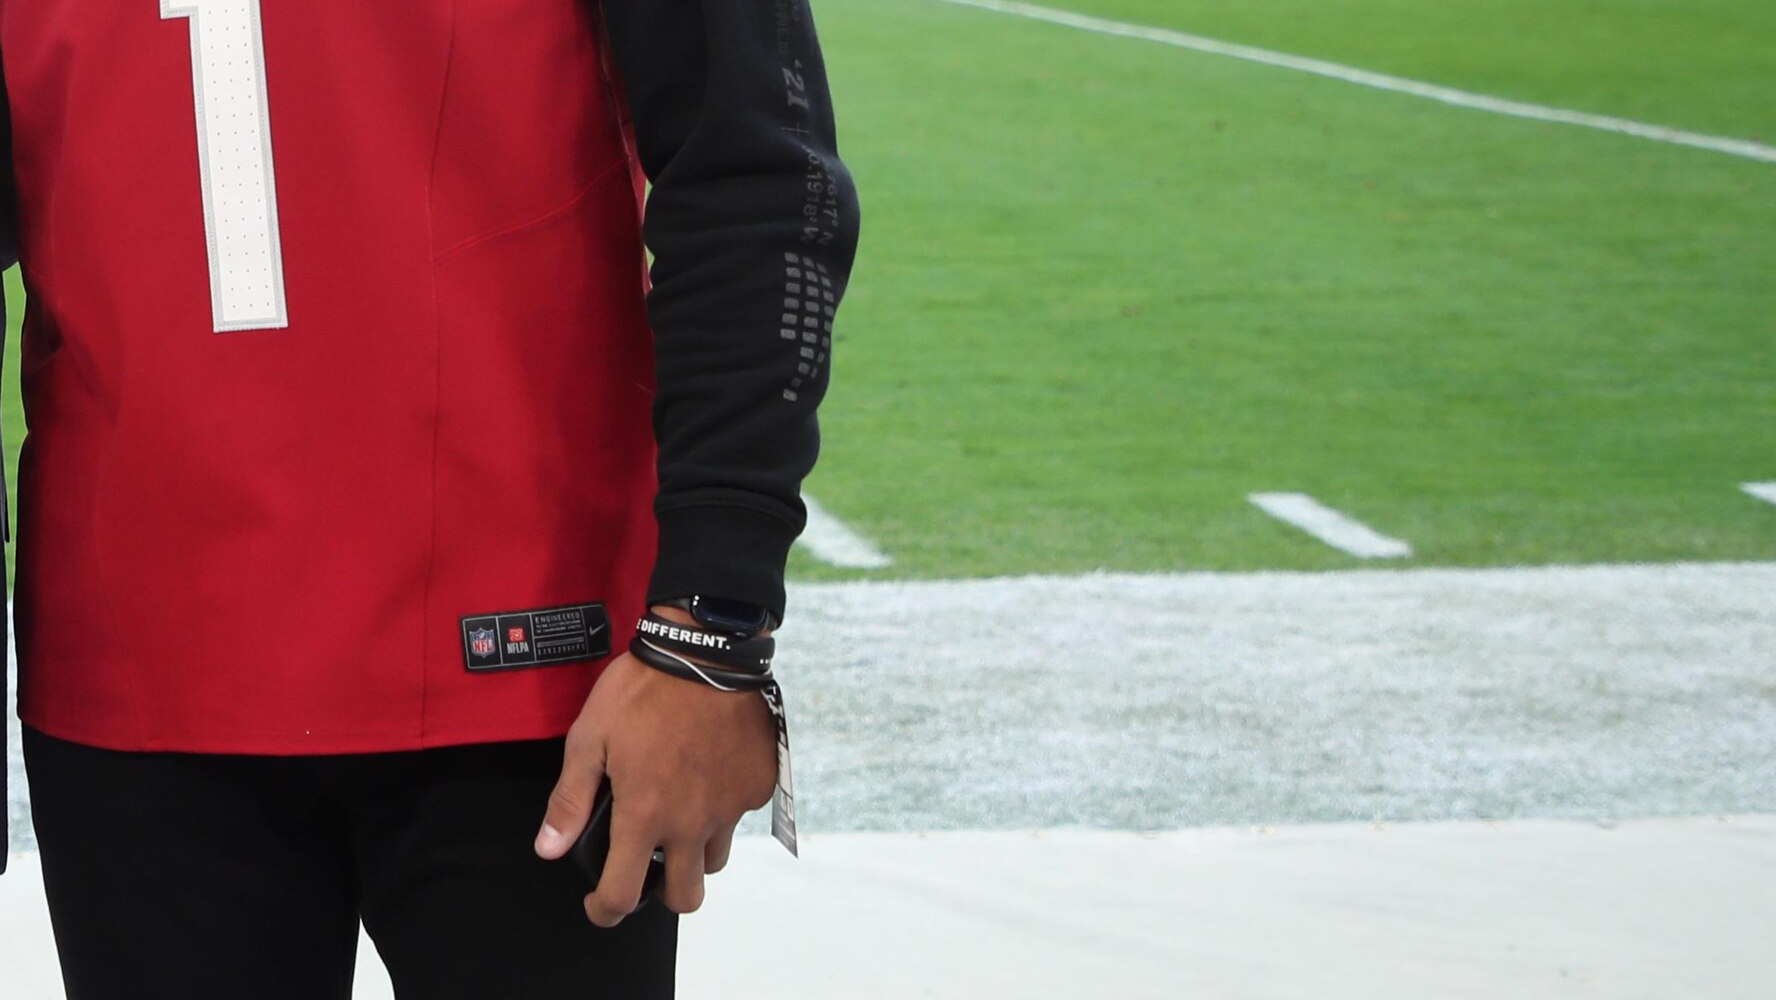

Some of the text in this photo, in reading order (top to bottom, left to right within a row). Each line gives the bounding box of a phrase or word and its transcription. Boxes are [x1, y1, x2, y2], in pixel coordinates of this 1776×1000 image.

[642, 623, 731, 650] DIFFERENT.
[472, 639, 495, 653] NFL
[506, 641, 530, 655] NFLPA
